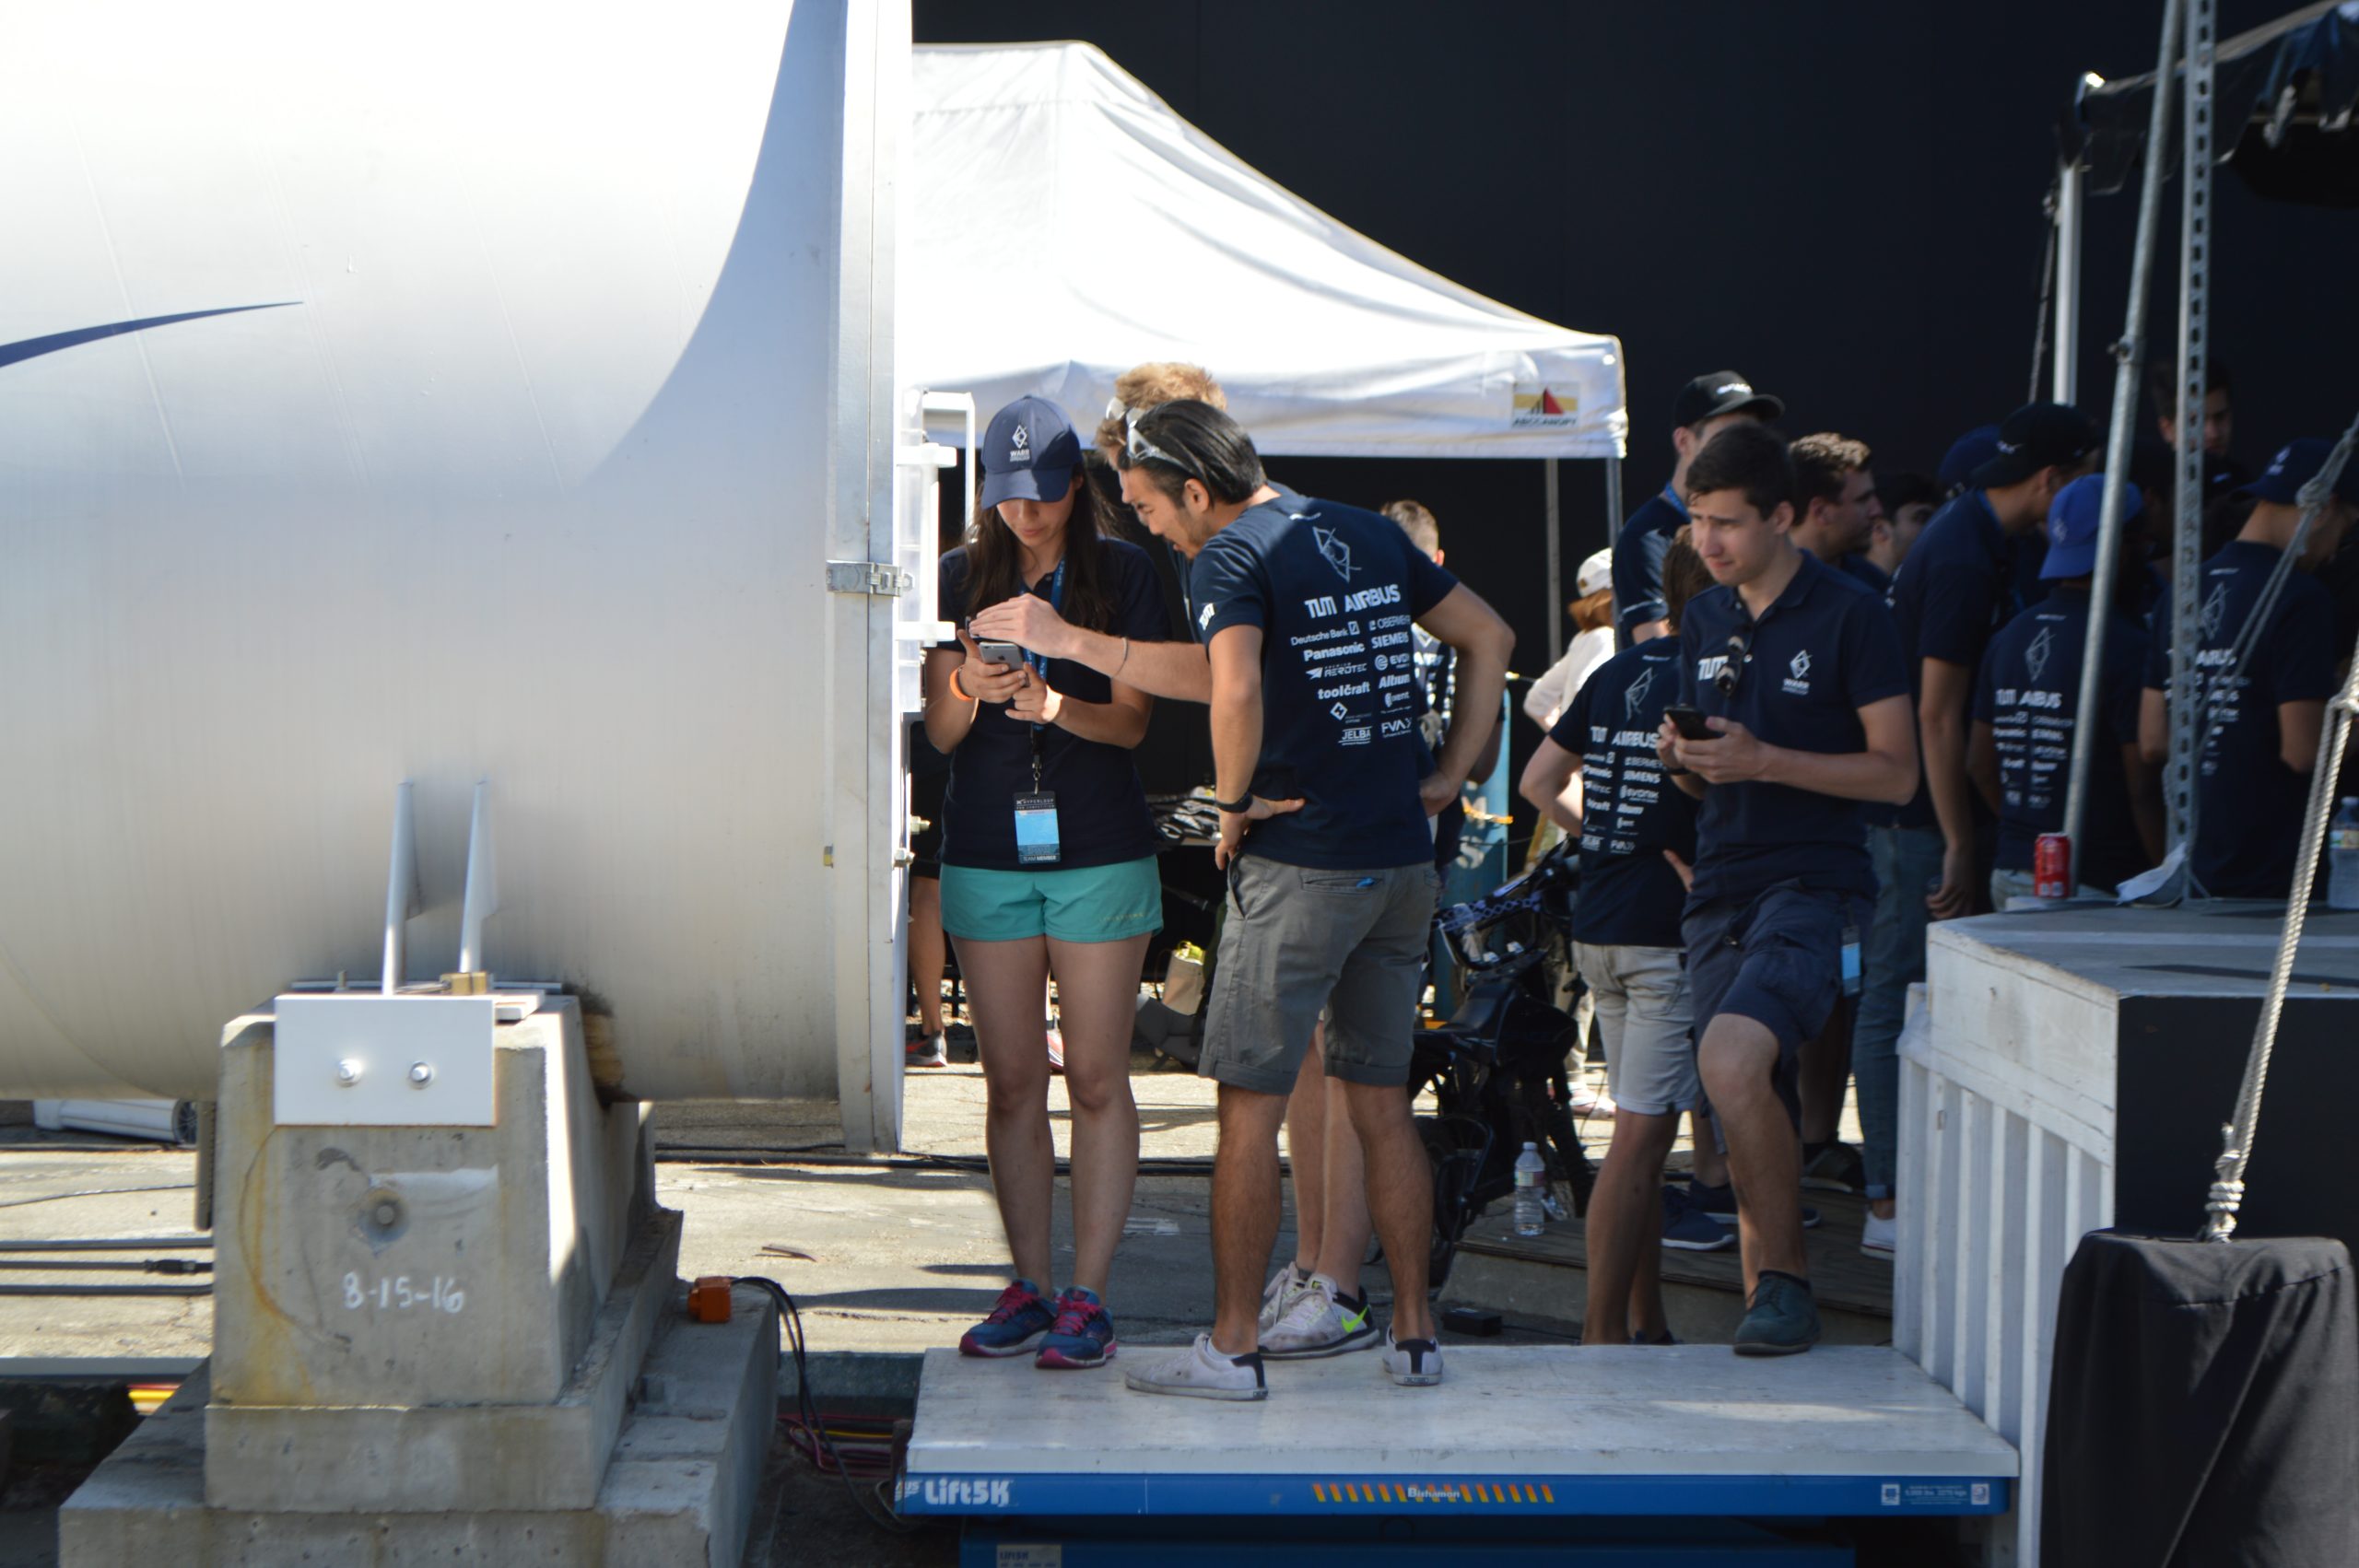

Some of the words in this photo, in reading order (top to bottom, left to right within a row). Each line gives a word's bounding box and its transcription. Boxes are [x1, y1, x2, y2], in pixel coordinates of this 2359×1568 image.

[1304, 596, 1338, 618] TUM
[1344, 584, 1402, 613] AIRBUS
[1303, 642, 1366, 661] Panasonic
[344, 1271, 464, 1313] 8-15-16
[925, 1478, 1010, 1507] Lift5K
[1408, 1487, 1461, 1499] Bishamon
